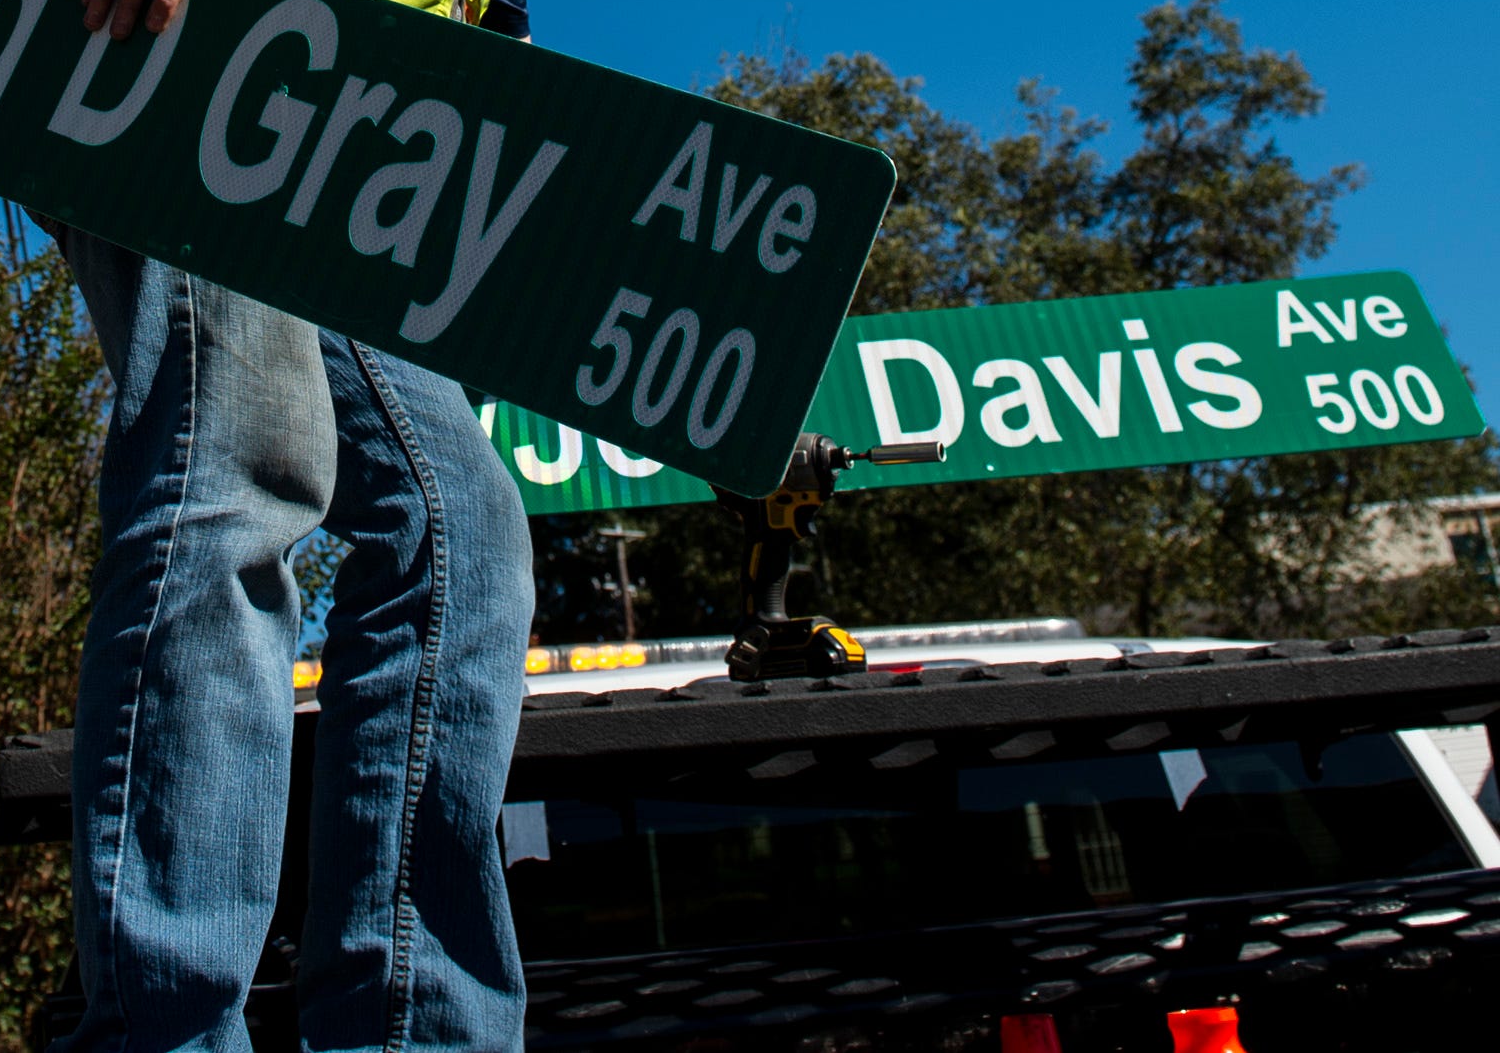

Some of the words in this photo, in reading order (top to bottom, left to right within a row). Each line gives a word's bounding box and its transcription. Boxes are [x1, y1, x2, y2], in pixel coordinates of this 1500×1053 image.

[632, 121, 817, 274] Ave
[577, 288, 756, 449] 500
[1277, 290, 1408, 347] Ave
[857, 319, 1263, 449] Davis
[1305, 365, 1445, 434] 500
